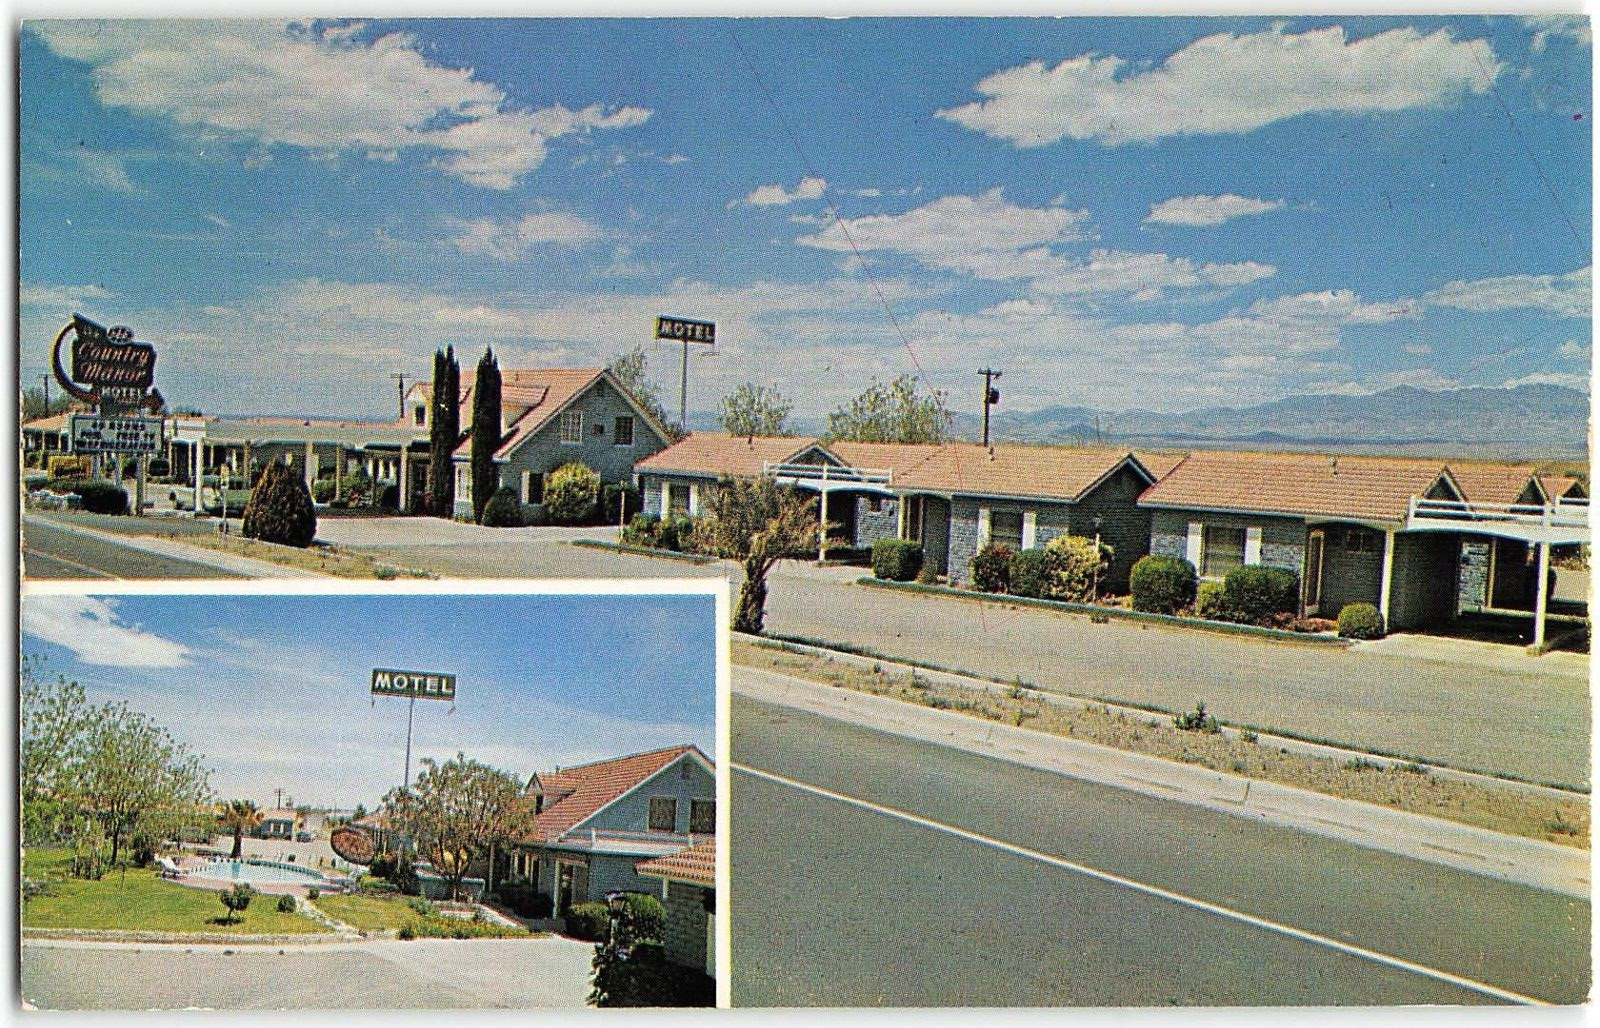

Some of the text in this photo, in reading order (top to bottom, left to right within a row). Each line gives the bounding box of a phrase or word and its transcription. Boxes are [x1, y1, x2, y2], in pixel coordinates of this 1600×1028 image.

[661, 320, 714, 340] MOTEL
[78, 341, 150, 367] Country
[80, 361, 147, 382] Manor
[375, 672, 453, 693] MOTEL
